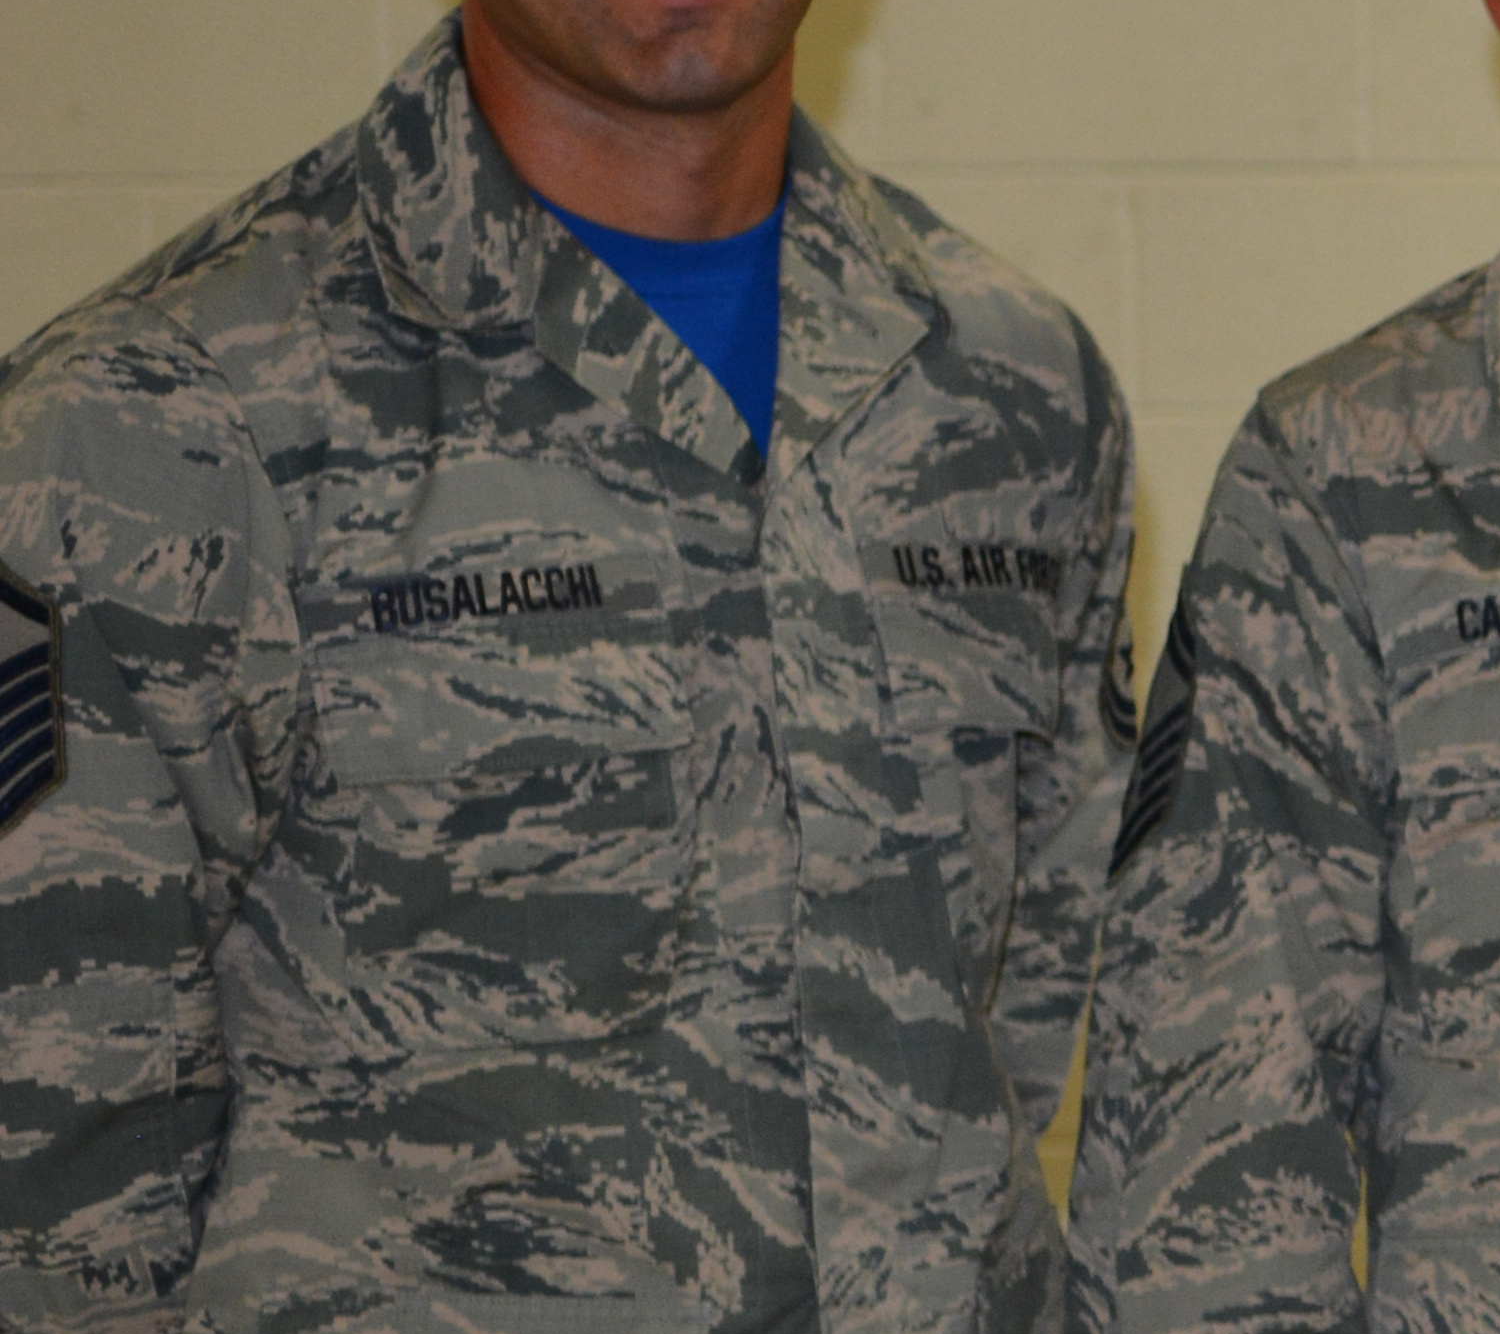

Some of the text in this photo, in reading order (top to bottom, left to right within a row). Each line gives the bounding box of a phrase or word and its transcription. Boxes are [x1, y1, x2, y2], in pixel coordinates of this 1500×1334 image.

[893, 545, 957, 589] U.S.
[961, 545, 1013, 588] AIR
[370, 562, 602, 633] BUSALACCHI
